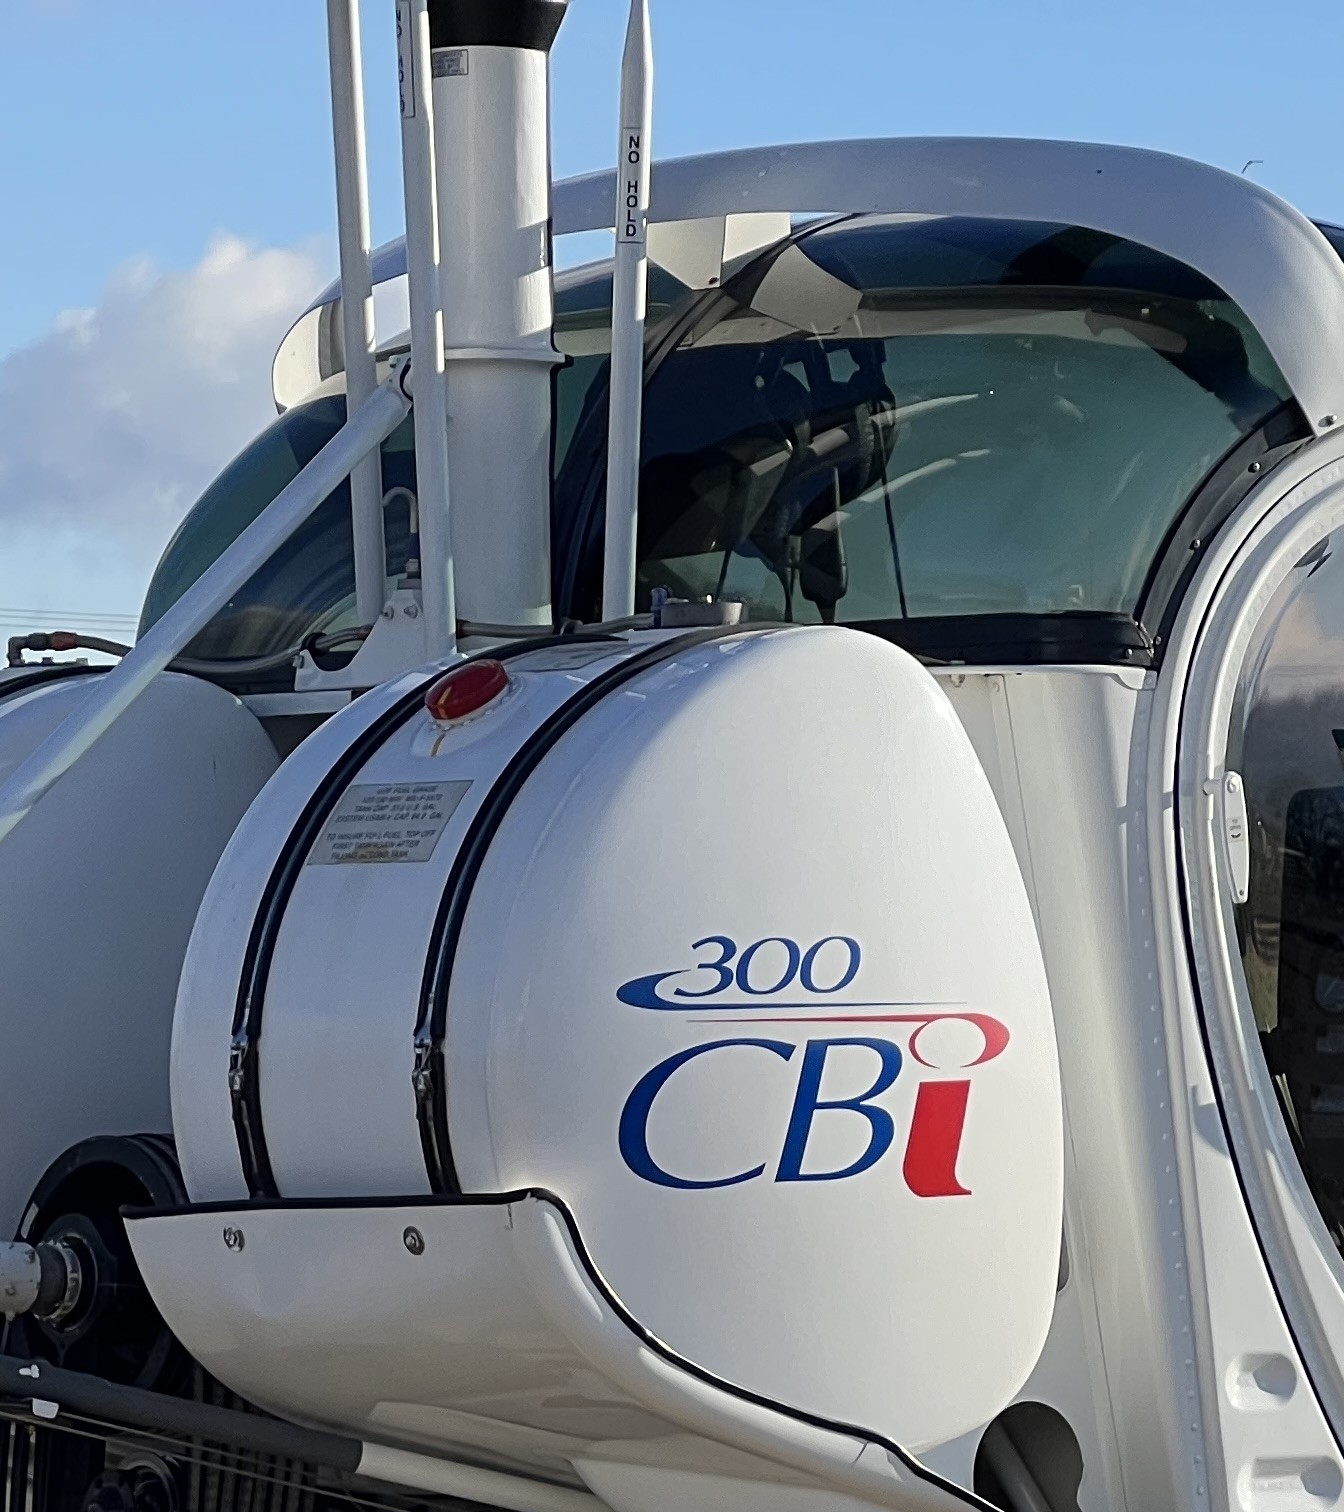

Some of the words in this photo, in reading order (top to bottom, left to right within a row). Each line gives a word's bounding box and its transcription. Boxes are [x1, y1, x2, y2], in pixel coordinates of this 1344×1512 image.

[628, 136, 640, 163] NO
[626, 181, 638, 237] HOLD
[675, 934, 861, 997] 300
[617, 1014, 1010, 1198] CBi
